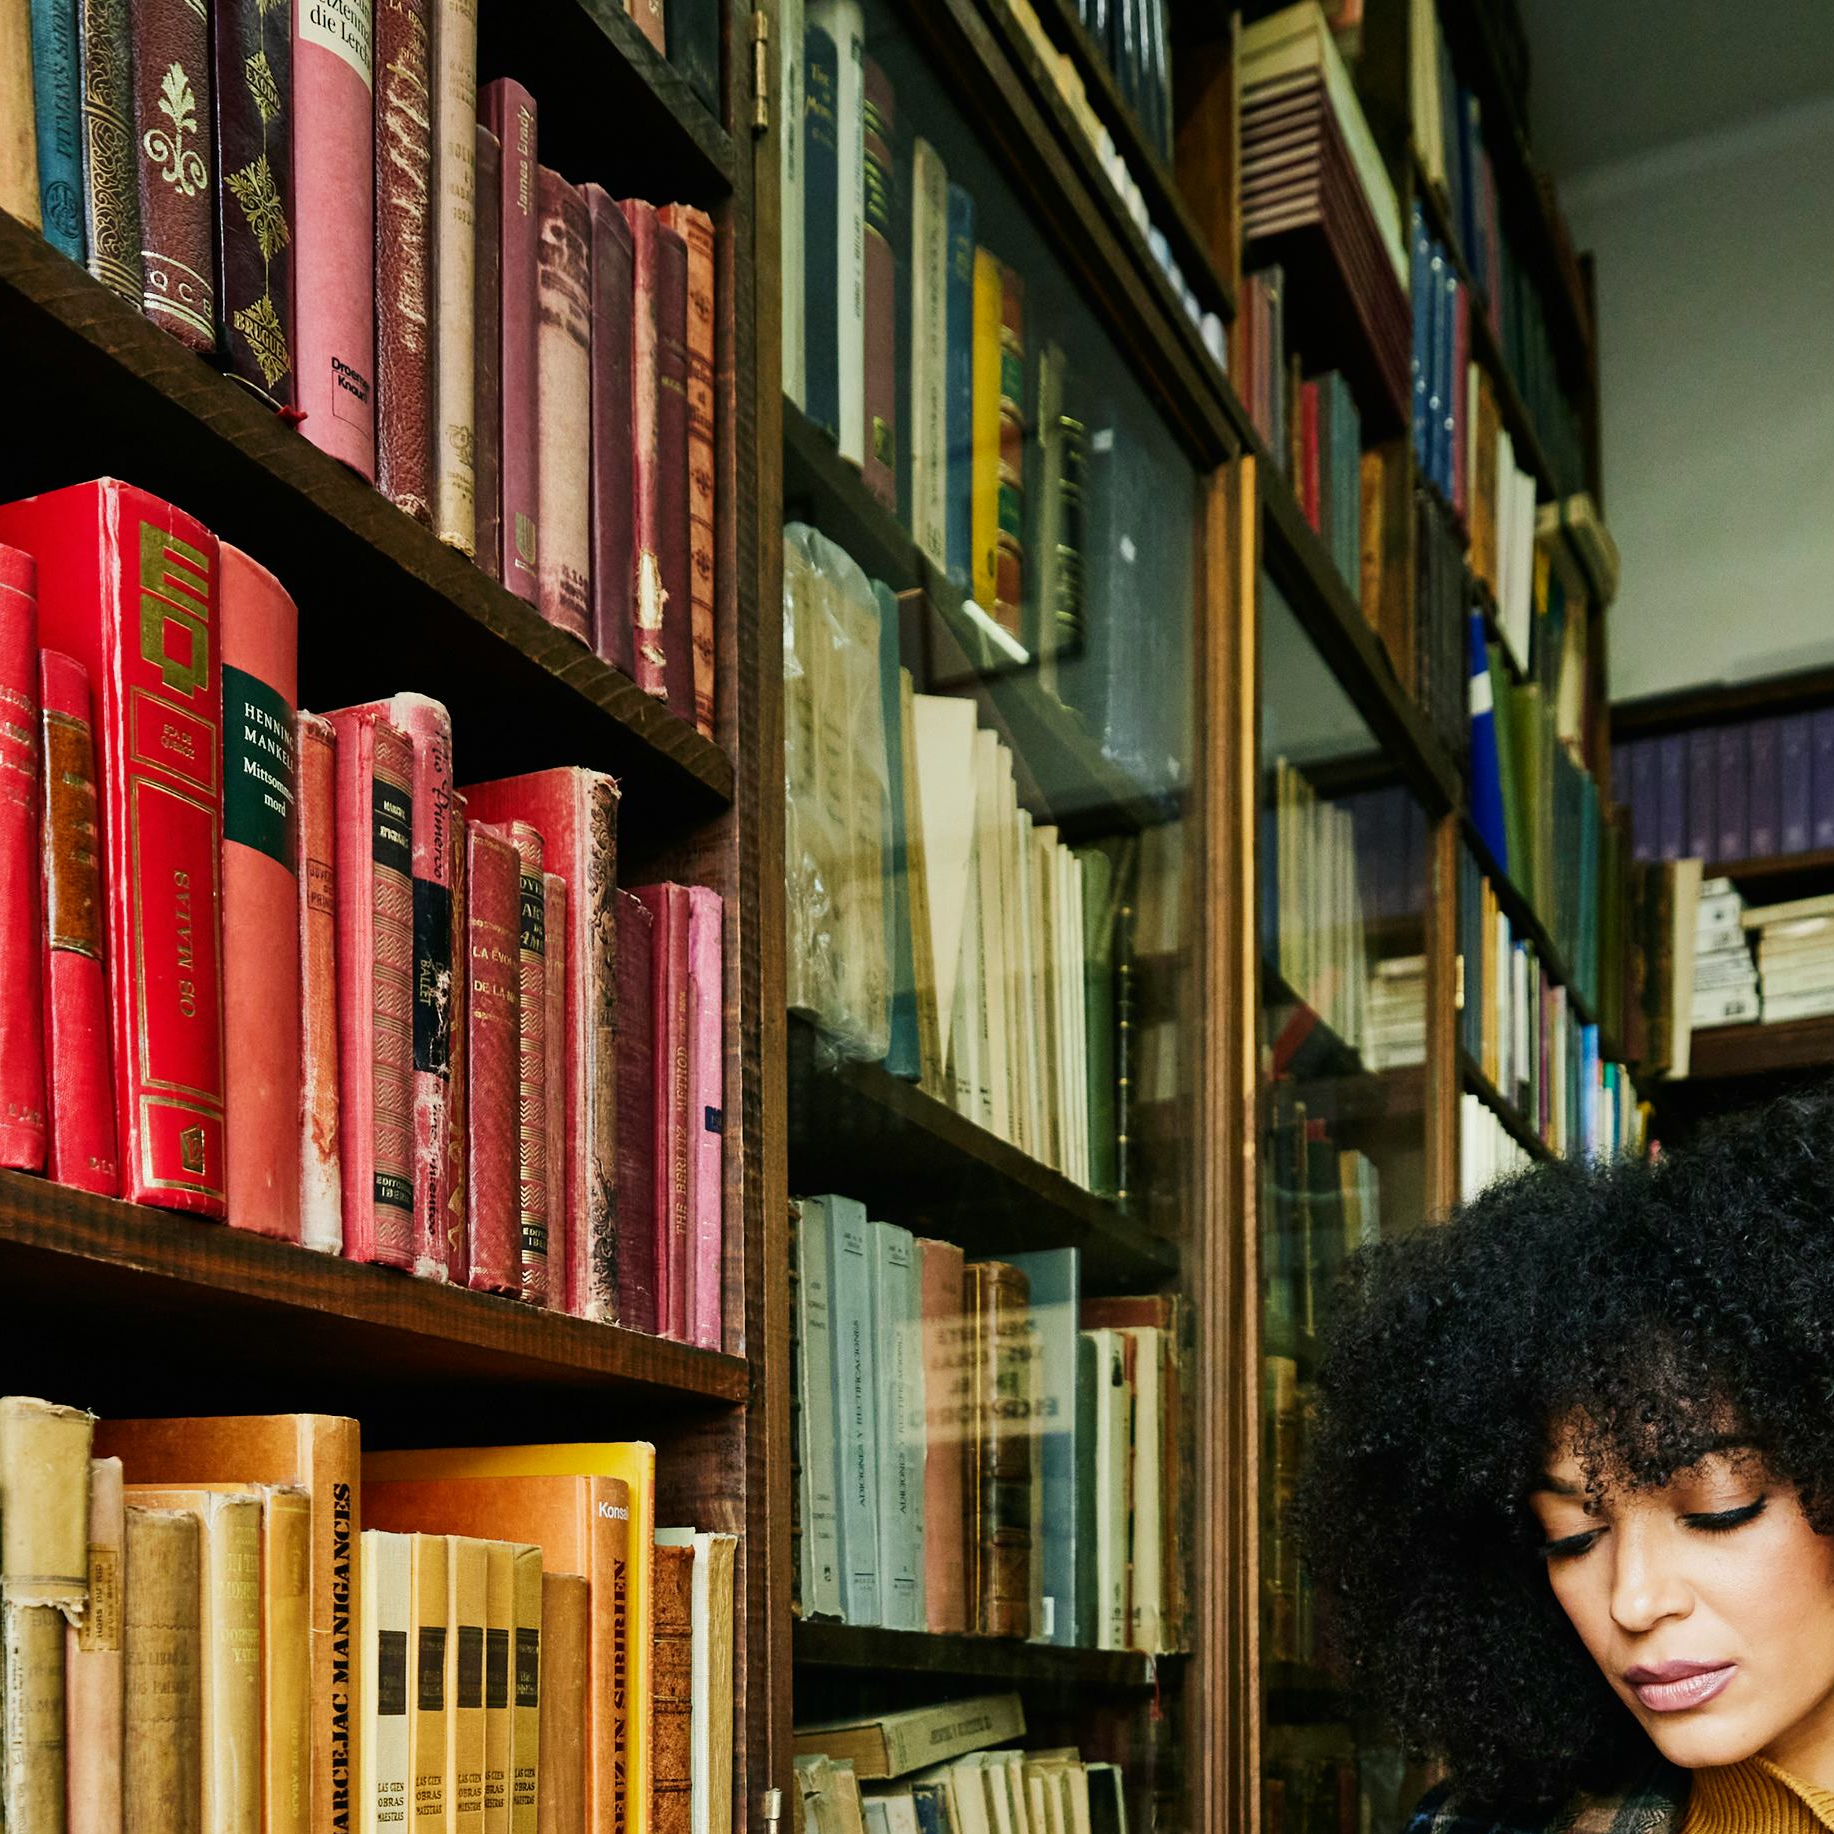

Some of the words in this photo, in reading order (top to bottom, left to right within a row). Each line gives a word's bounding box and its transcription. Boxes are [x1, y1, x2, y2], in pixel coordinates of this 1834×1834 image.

[310, 7, 336, 33] die
[244, 702, 296, 748] HENNING
[244, 725, 296, 773] MANKELL
[264, 792, 287, 817] mord
[174, 869, 193, 969] MAIAS
[472, 945, 488, 960] LA
[473, 979, 489, 994] DE
[179, 981, 196, 1018] OS
[675, 1046, 689, 1114] METHOD
[674, 1127, 689, 1197] BERLITZ
[674, 1207, 688, 1237] THE
[332, 1482, 352, 1685] MANIGANCES
[458, 1773, 470, 1785] LAS
[470, 1773, 482, 1784] CIEN
[514, 1768, 525, 1780] LAS
[525, 1768, 536, 1780] CIEN
[377, 1782, 390, 1795] LAS
[390, 1781, 404, 1793] CIEN
[416, 1776, 428, 1788] LAS
[428, 1775, 442, 1787] CIEN
[514, 1780, 536, 1793] OBRAS
[415, 1788, 443, 1801] OBRAS
[458, 1786, 482, 1798] OBRAS
[377, 1795, 405, 1808] OBRAS
[457, 1800, 482, 1812] MAESTRAS
[513, 1794, 536, 1806] MAESTRAS
[376, 1809, 405, 1823] MAESTRAS
[415, 1803, 443, 1816] MAESTRAS
